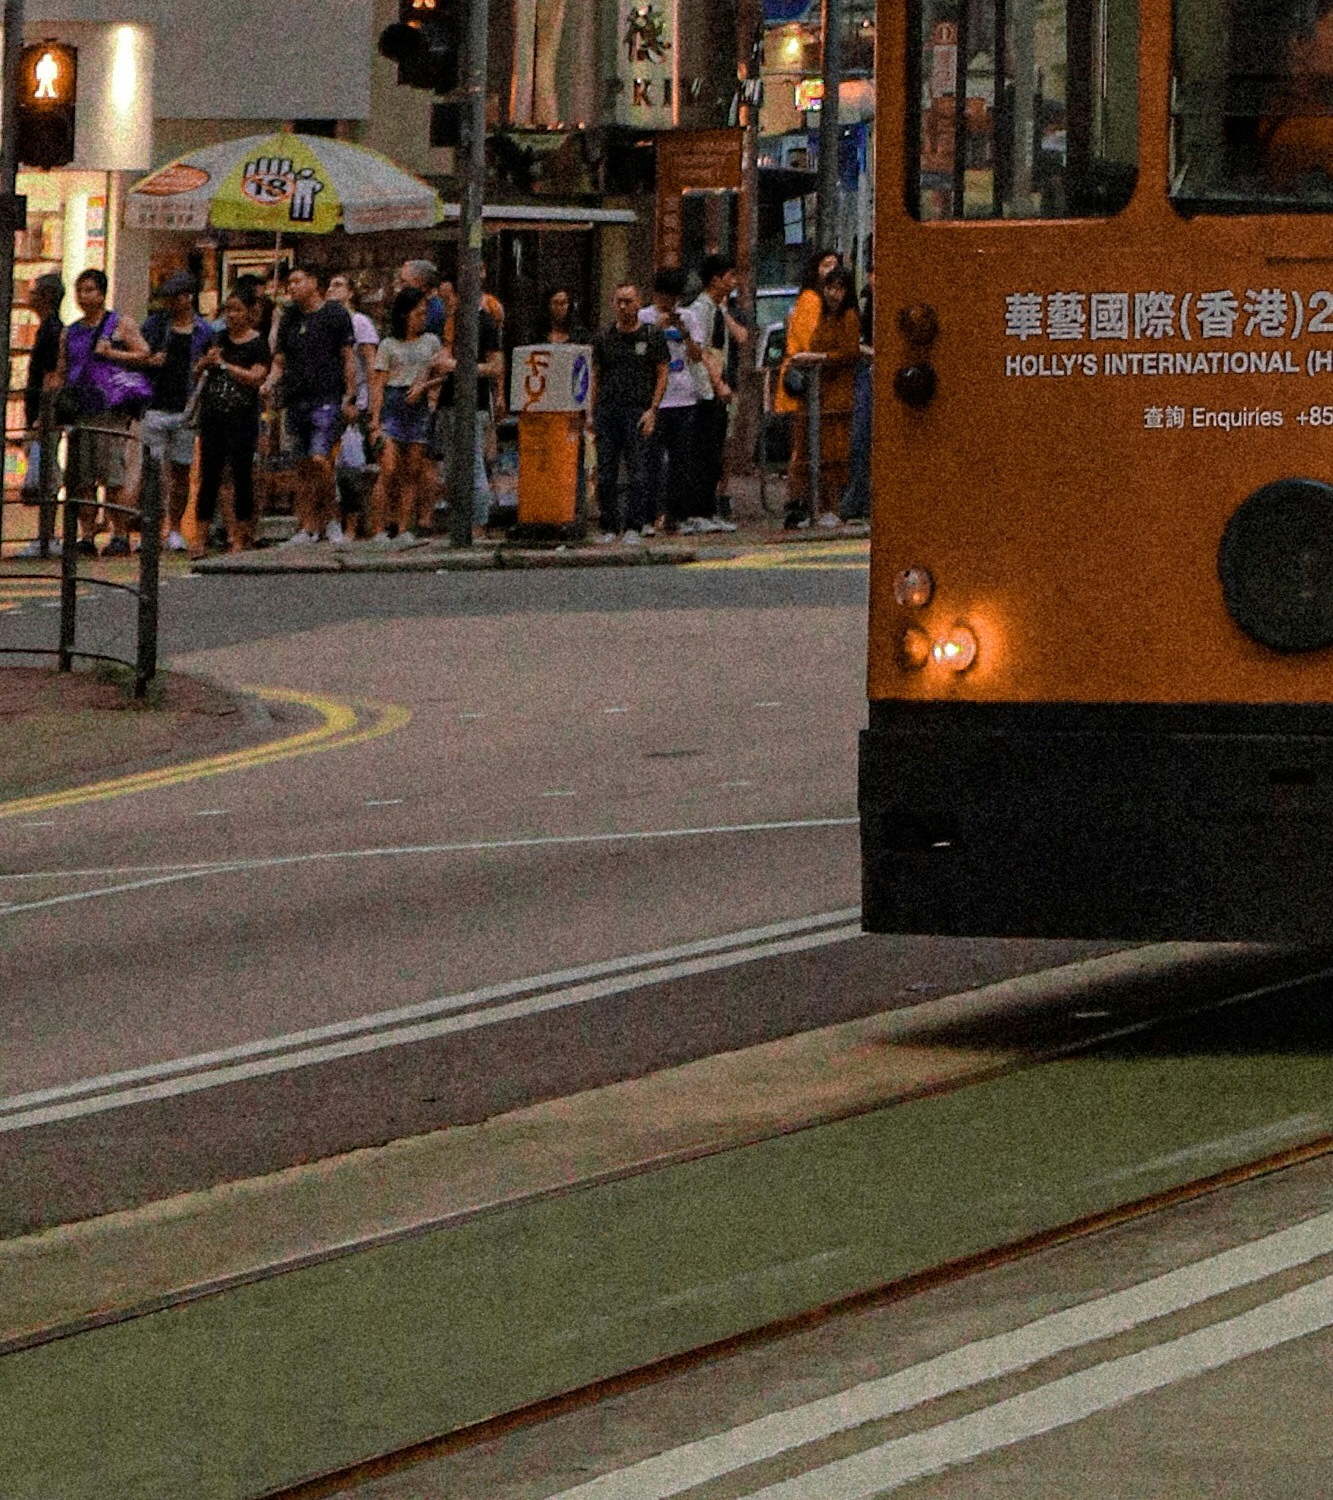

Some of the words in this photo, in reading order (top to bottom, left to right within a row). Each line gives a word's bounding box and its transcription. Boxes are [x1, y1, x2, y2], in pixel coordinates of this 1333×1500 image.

[1004, 352, 1097, 379] HOLLY'S
[1103, 349, 1301, 377] INTERNATIONAL
[1143, 403, 1186, 431] 查詢
[1190, 403, 1283, 431] Enquiries
